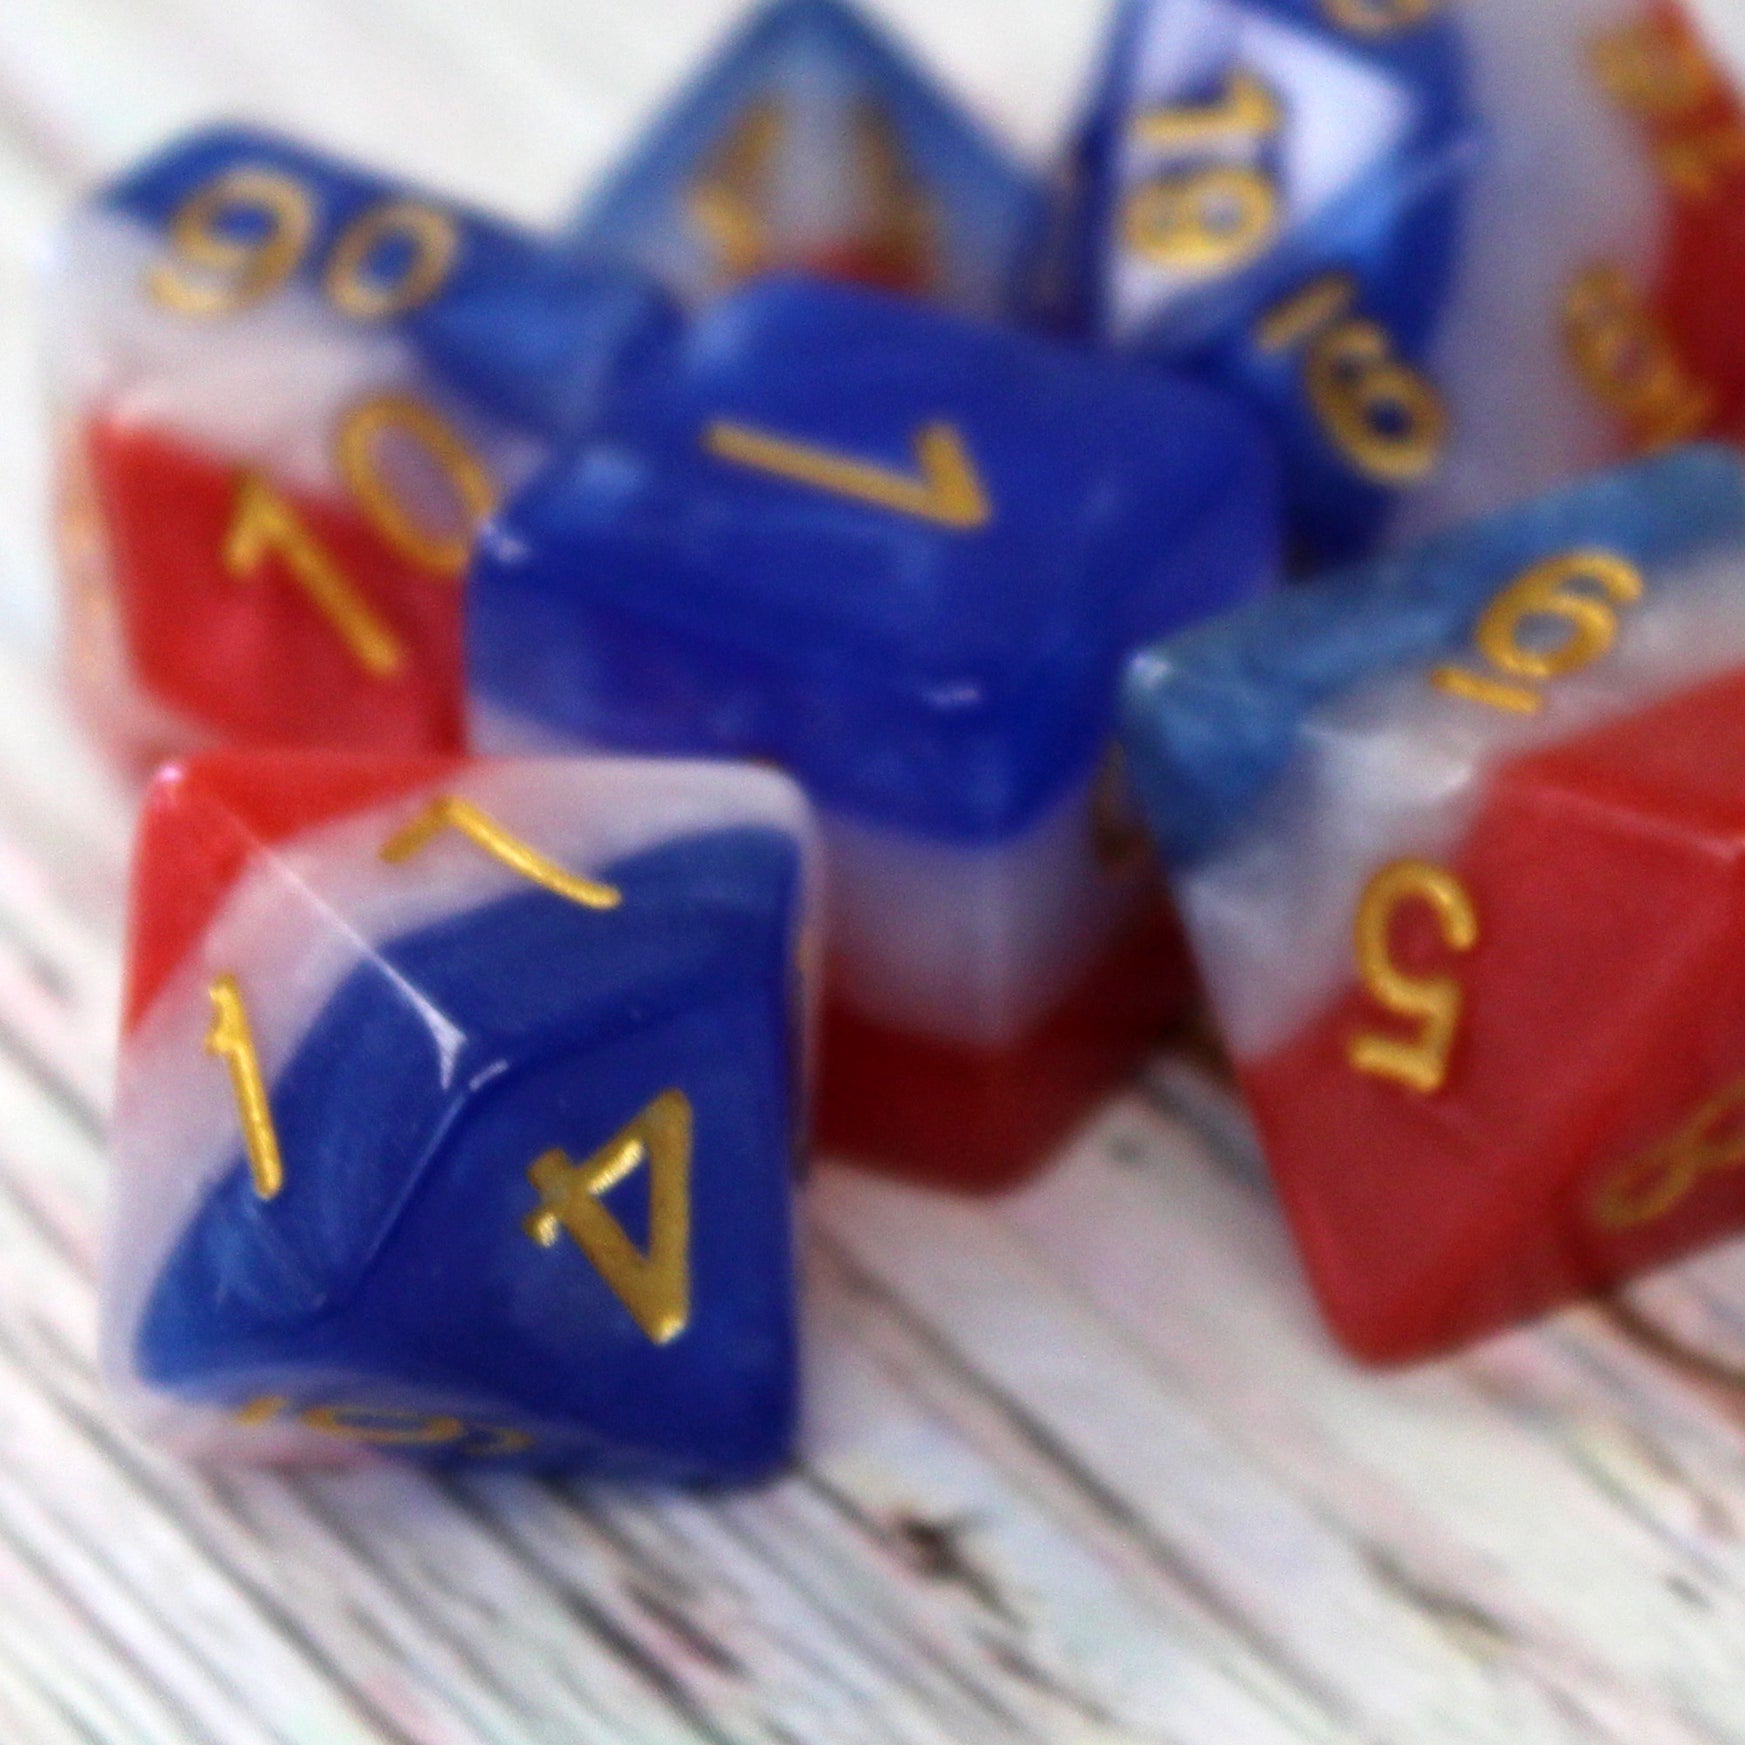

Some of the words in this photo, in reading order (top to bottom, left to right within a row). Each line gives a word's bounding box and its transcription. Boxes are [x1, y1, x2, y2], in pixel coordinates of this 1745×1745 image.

[147, 167, 458, 321] 90
[224, 392, 495, 677] 10
[703, 416, 993, 531] 1
[206, 973, 283, 1200] 1
[1347, 857, 1479, 1092] 5
[523, 1086, 694, 1345] 4
